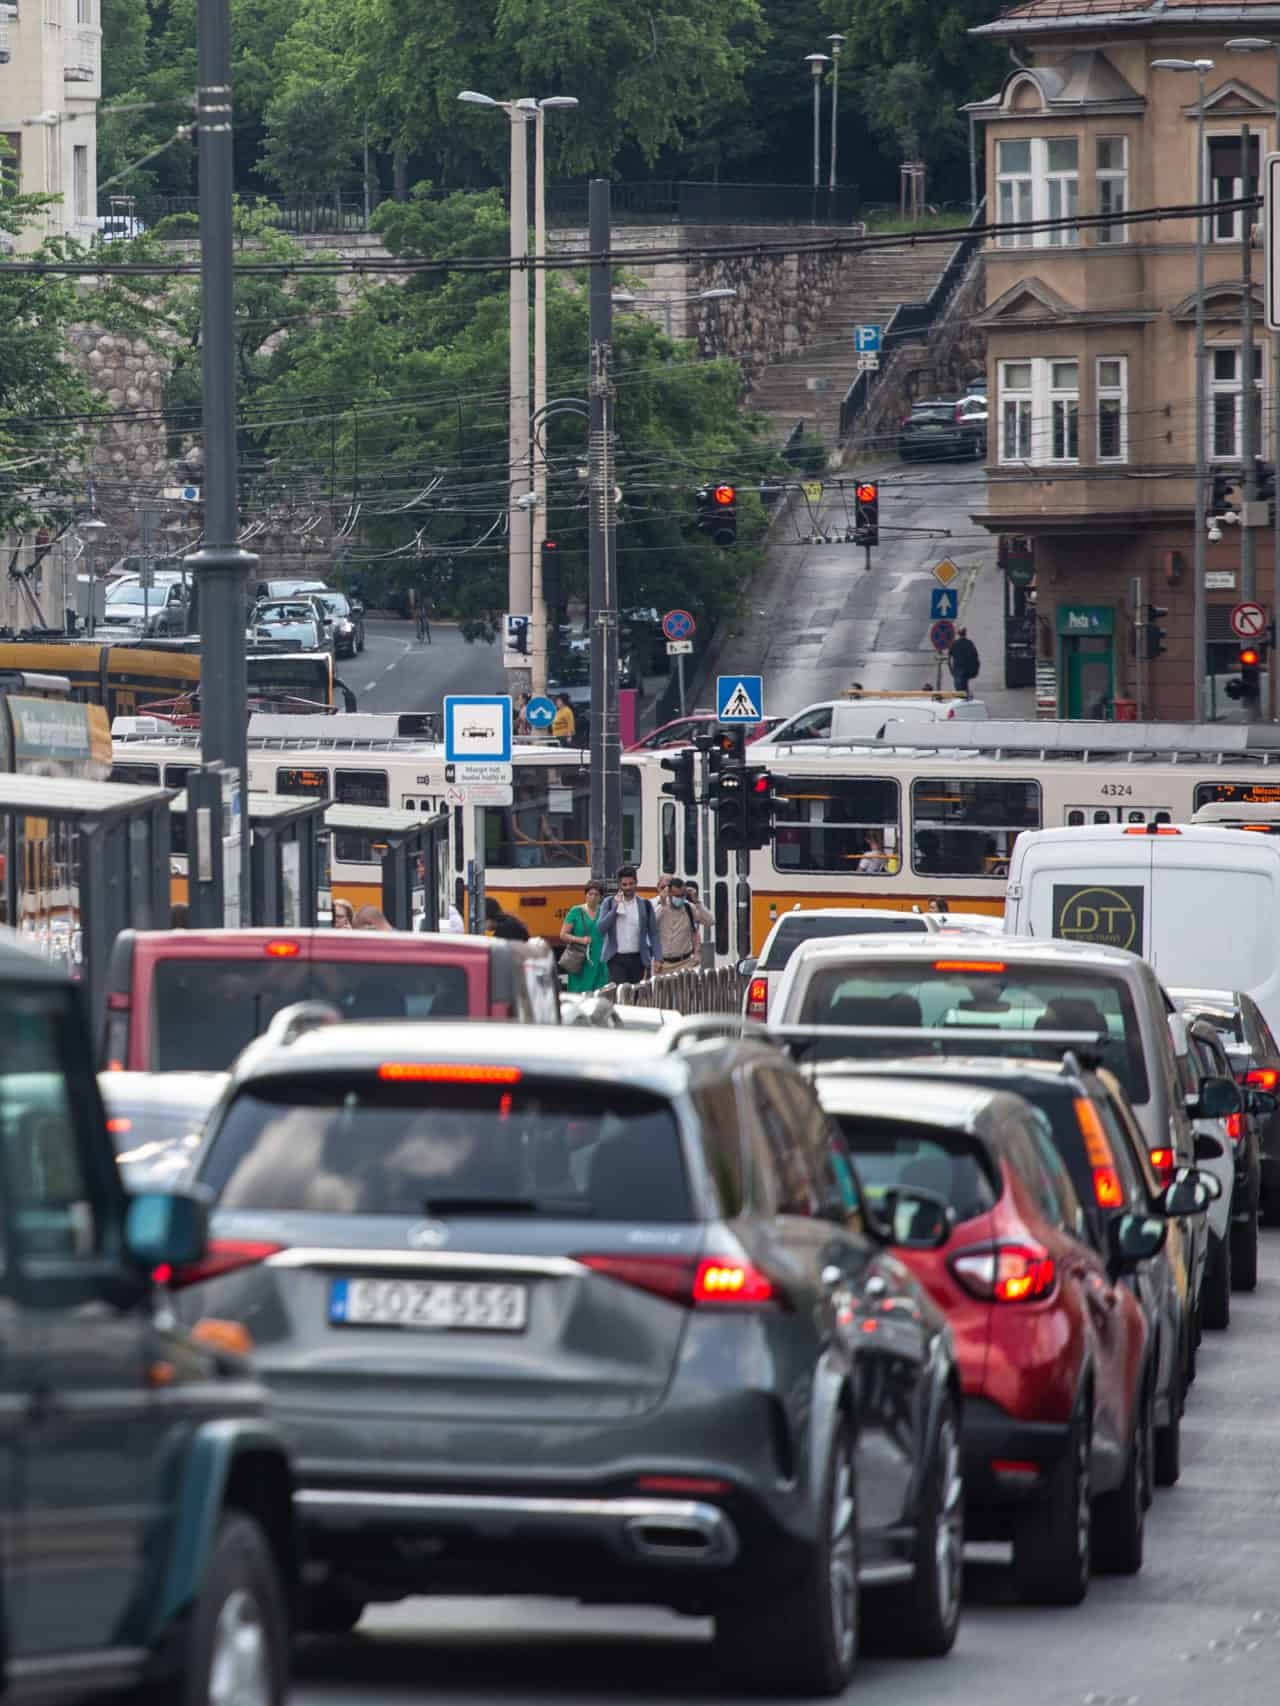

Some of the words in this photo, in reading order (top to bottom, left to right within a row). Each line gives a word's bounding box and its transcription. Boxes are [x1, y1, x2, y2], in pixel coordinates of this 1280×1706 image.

[859, 329, 876, 349] P
[1101, 784, 1132, 796] 4324
[1076, 906, 1131, 933] DT
